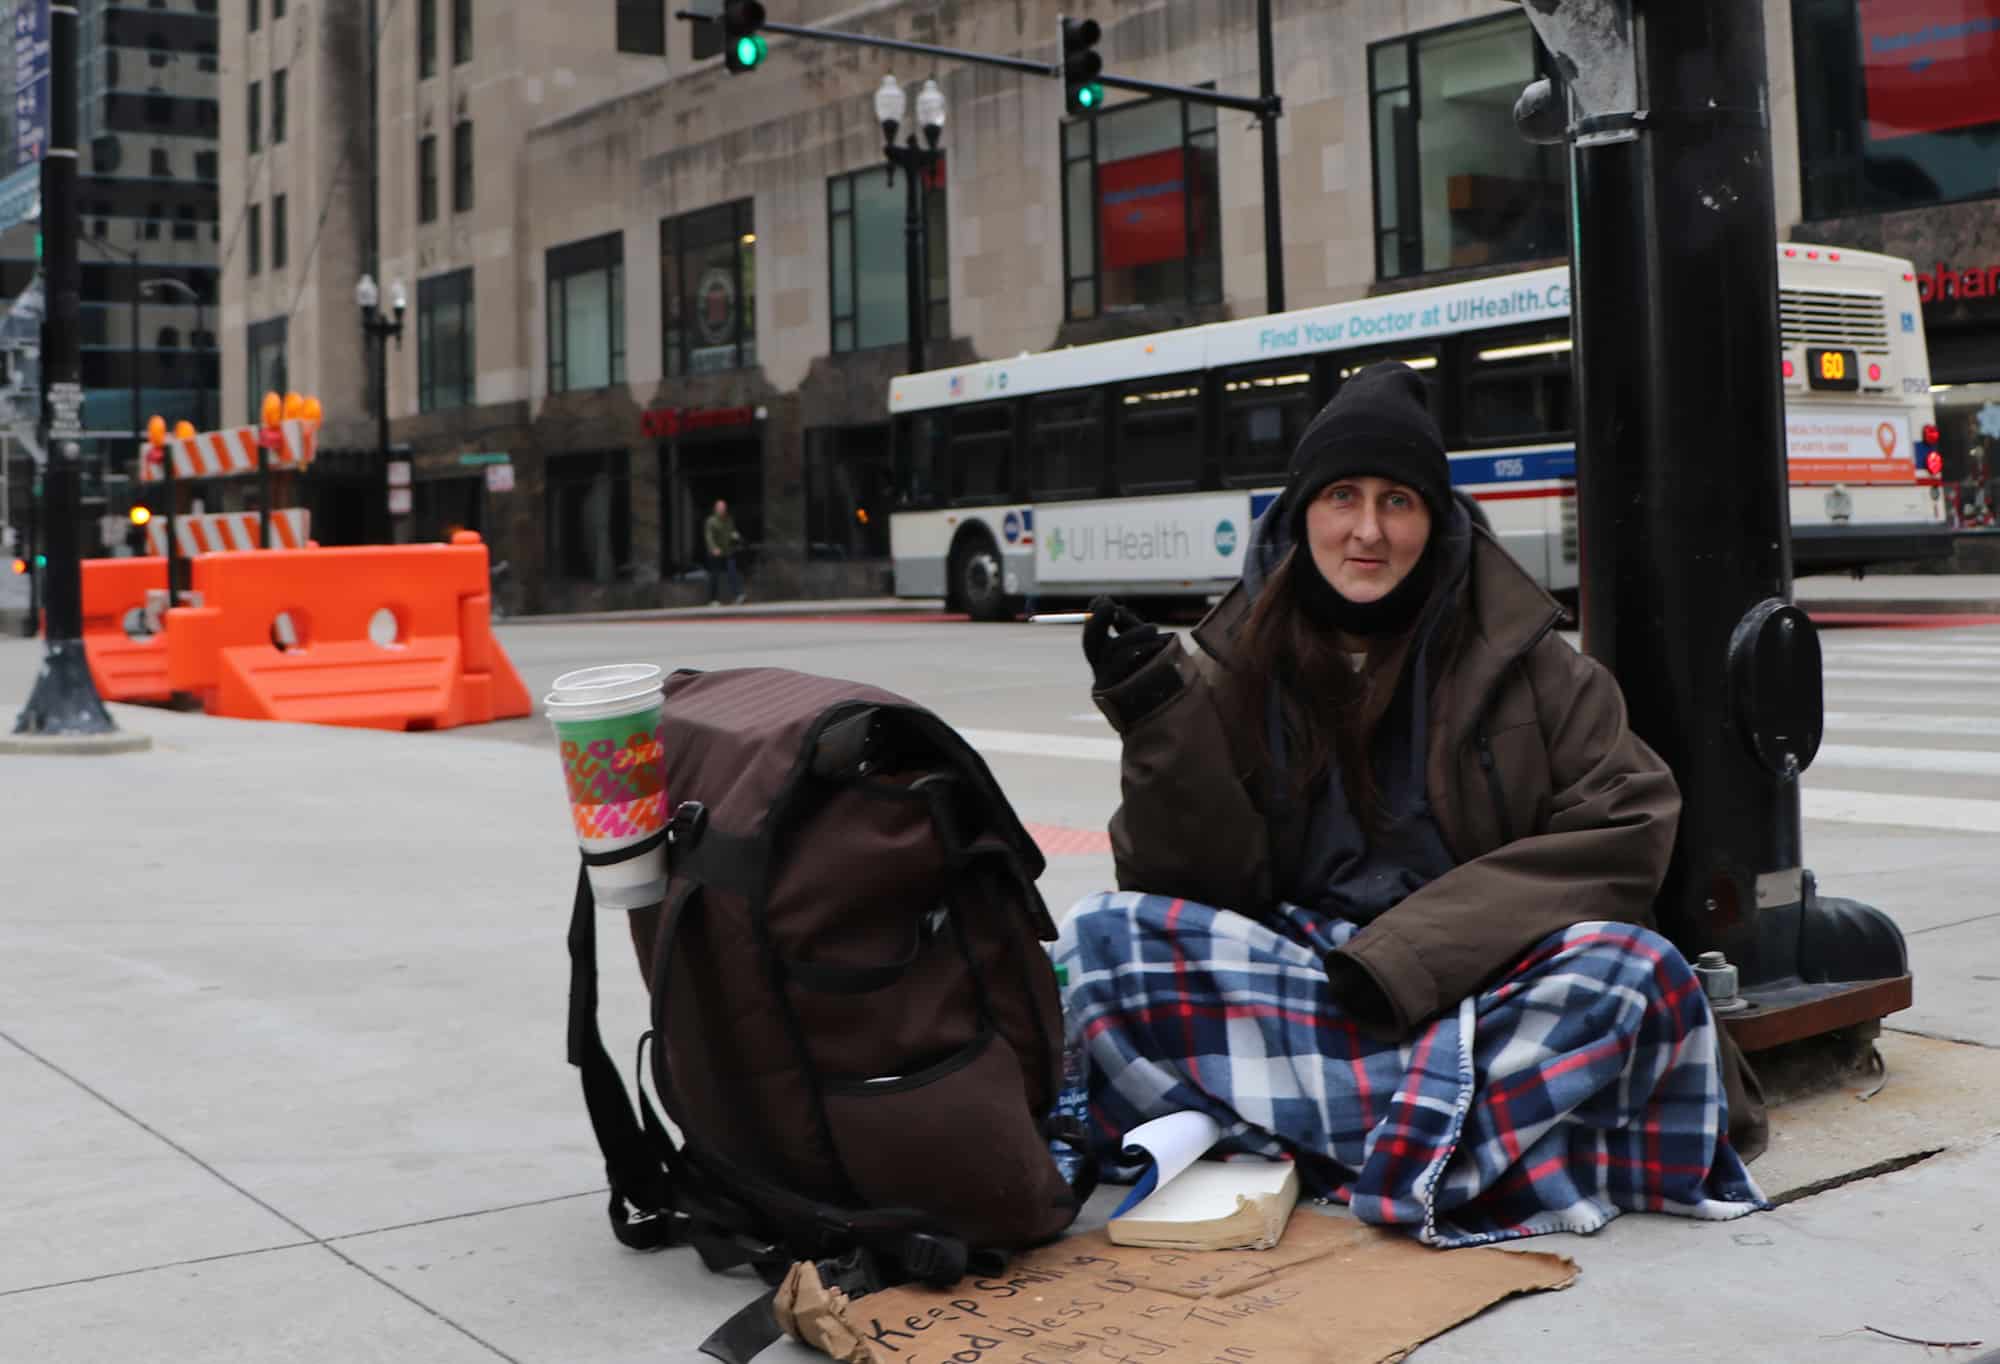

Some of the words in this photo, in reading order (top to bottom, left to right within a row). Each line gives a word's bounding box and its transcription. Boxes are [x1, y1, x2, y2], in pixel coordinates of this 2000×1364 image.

[1260, 329, 1298, 349] Find
[1304, 322, 1344, 345] Your
[1350, 310, 1414, 338] Doctor
[1420, 306, 1441, 326] at
[1820, 351, 1845, 380] 60
[1069, 527, 1095, 562] UI
[1104, 519, 1190, 558] Health
[865, 1299, 988, 1352] Keep
[988, 1298, 1105, 1338] bless
